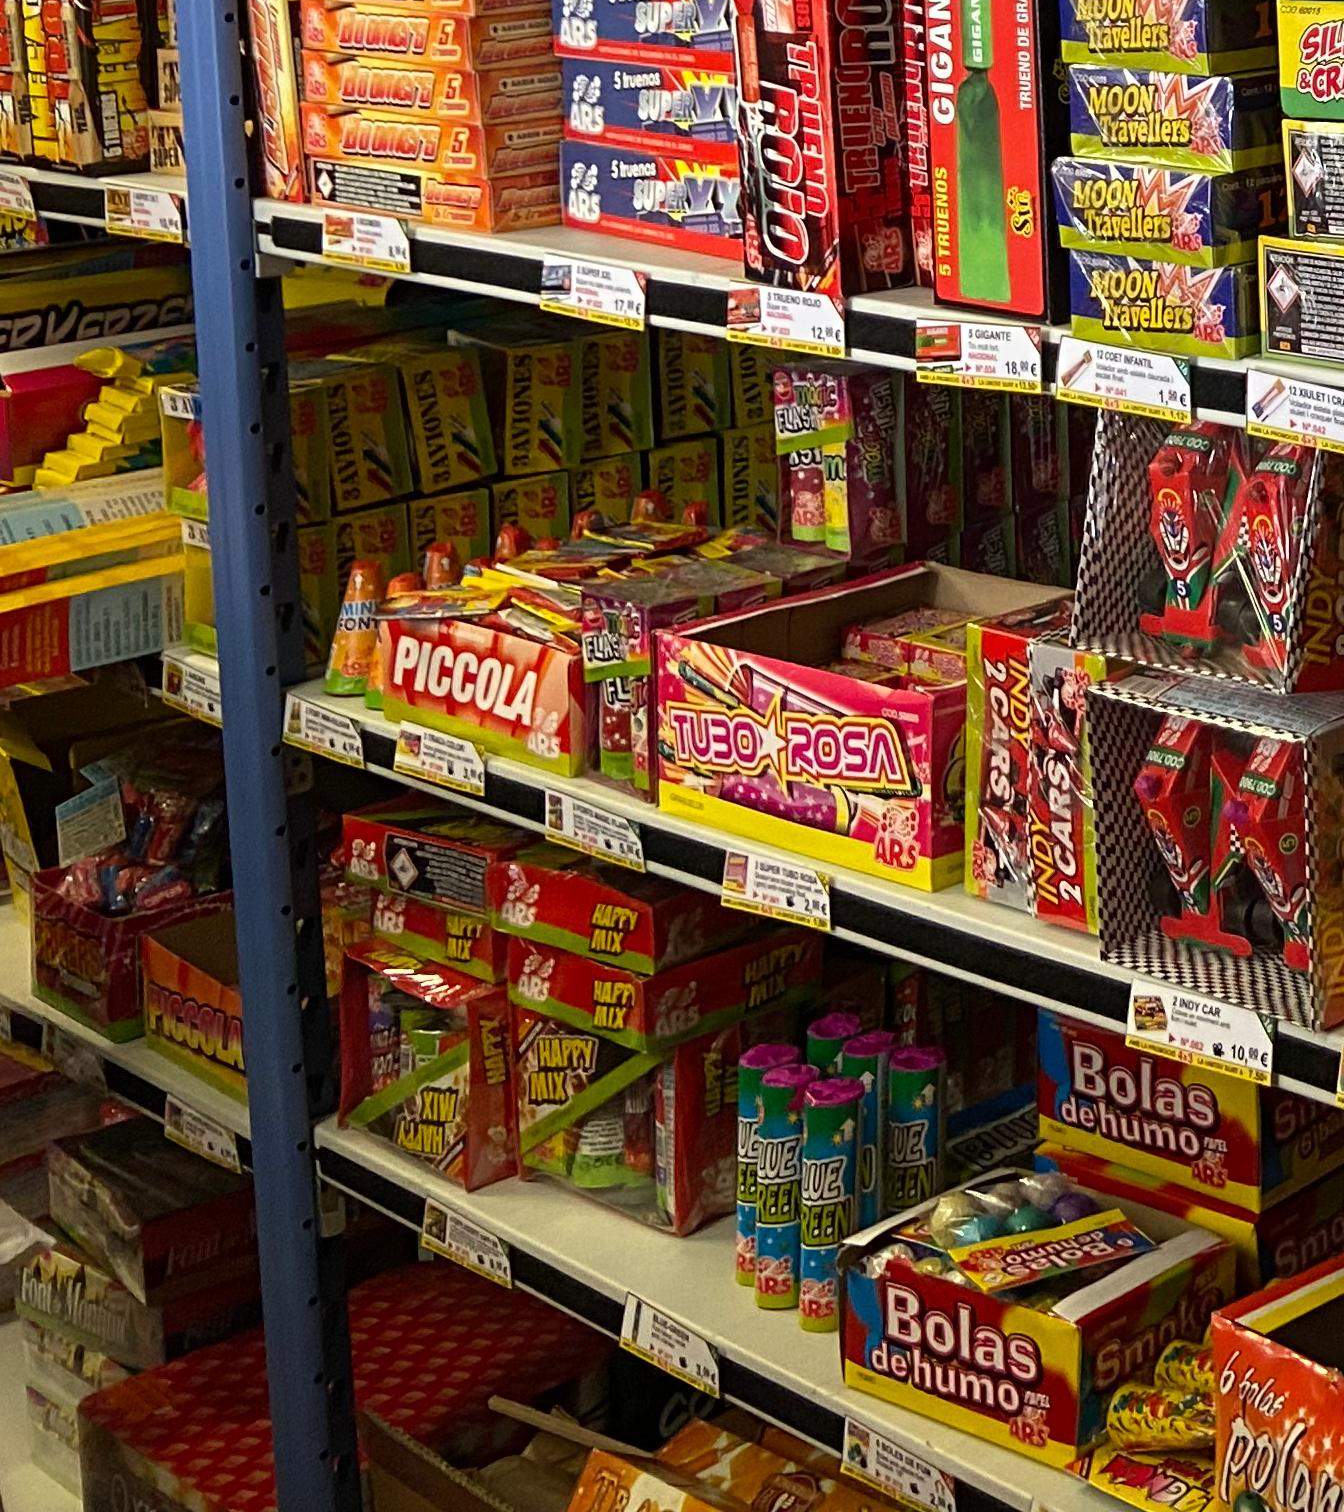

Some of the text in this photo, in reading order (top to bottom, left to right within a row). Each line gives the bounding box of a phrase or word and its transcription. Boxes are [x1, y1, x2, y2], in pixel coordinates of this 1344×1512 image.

[1018, 18, 1031, 42] DE
[1019, 46, 1034, 111] TRUENO
[936, 166, 951, 277] 5 TRUENOS
[391, 636, 538, 727] PICCOLA
[669, 704, 908, 783] TUBO ROSA
[1172, 996, 1221, 1018] 2 INDY CAR
[884, 1282, 1041, 1383] Bolas
[911, 1356, 1020, 1413] humo
